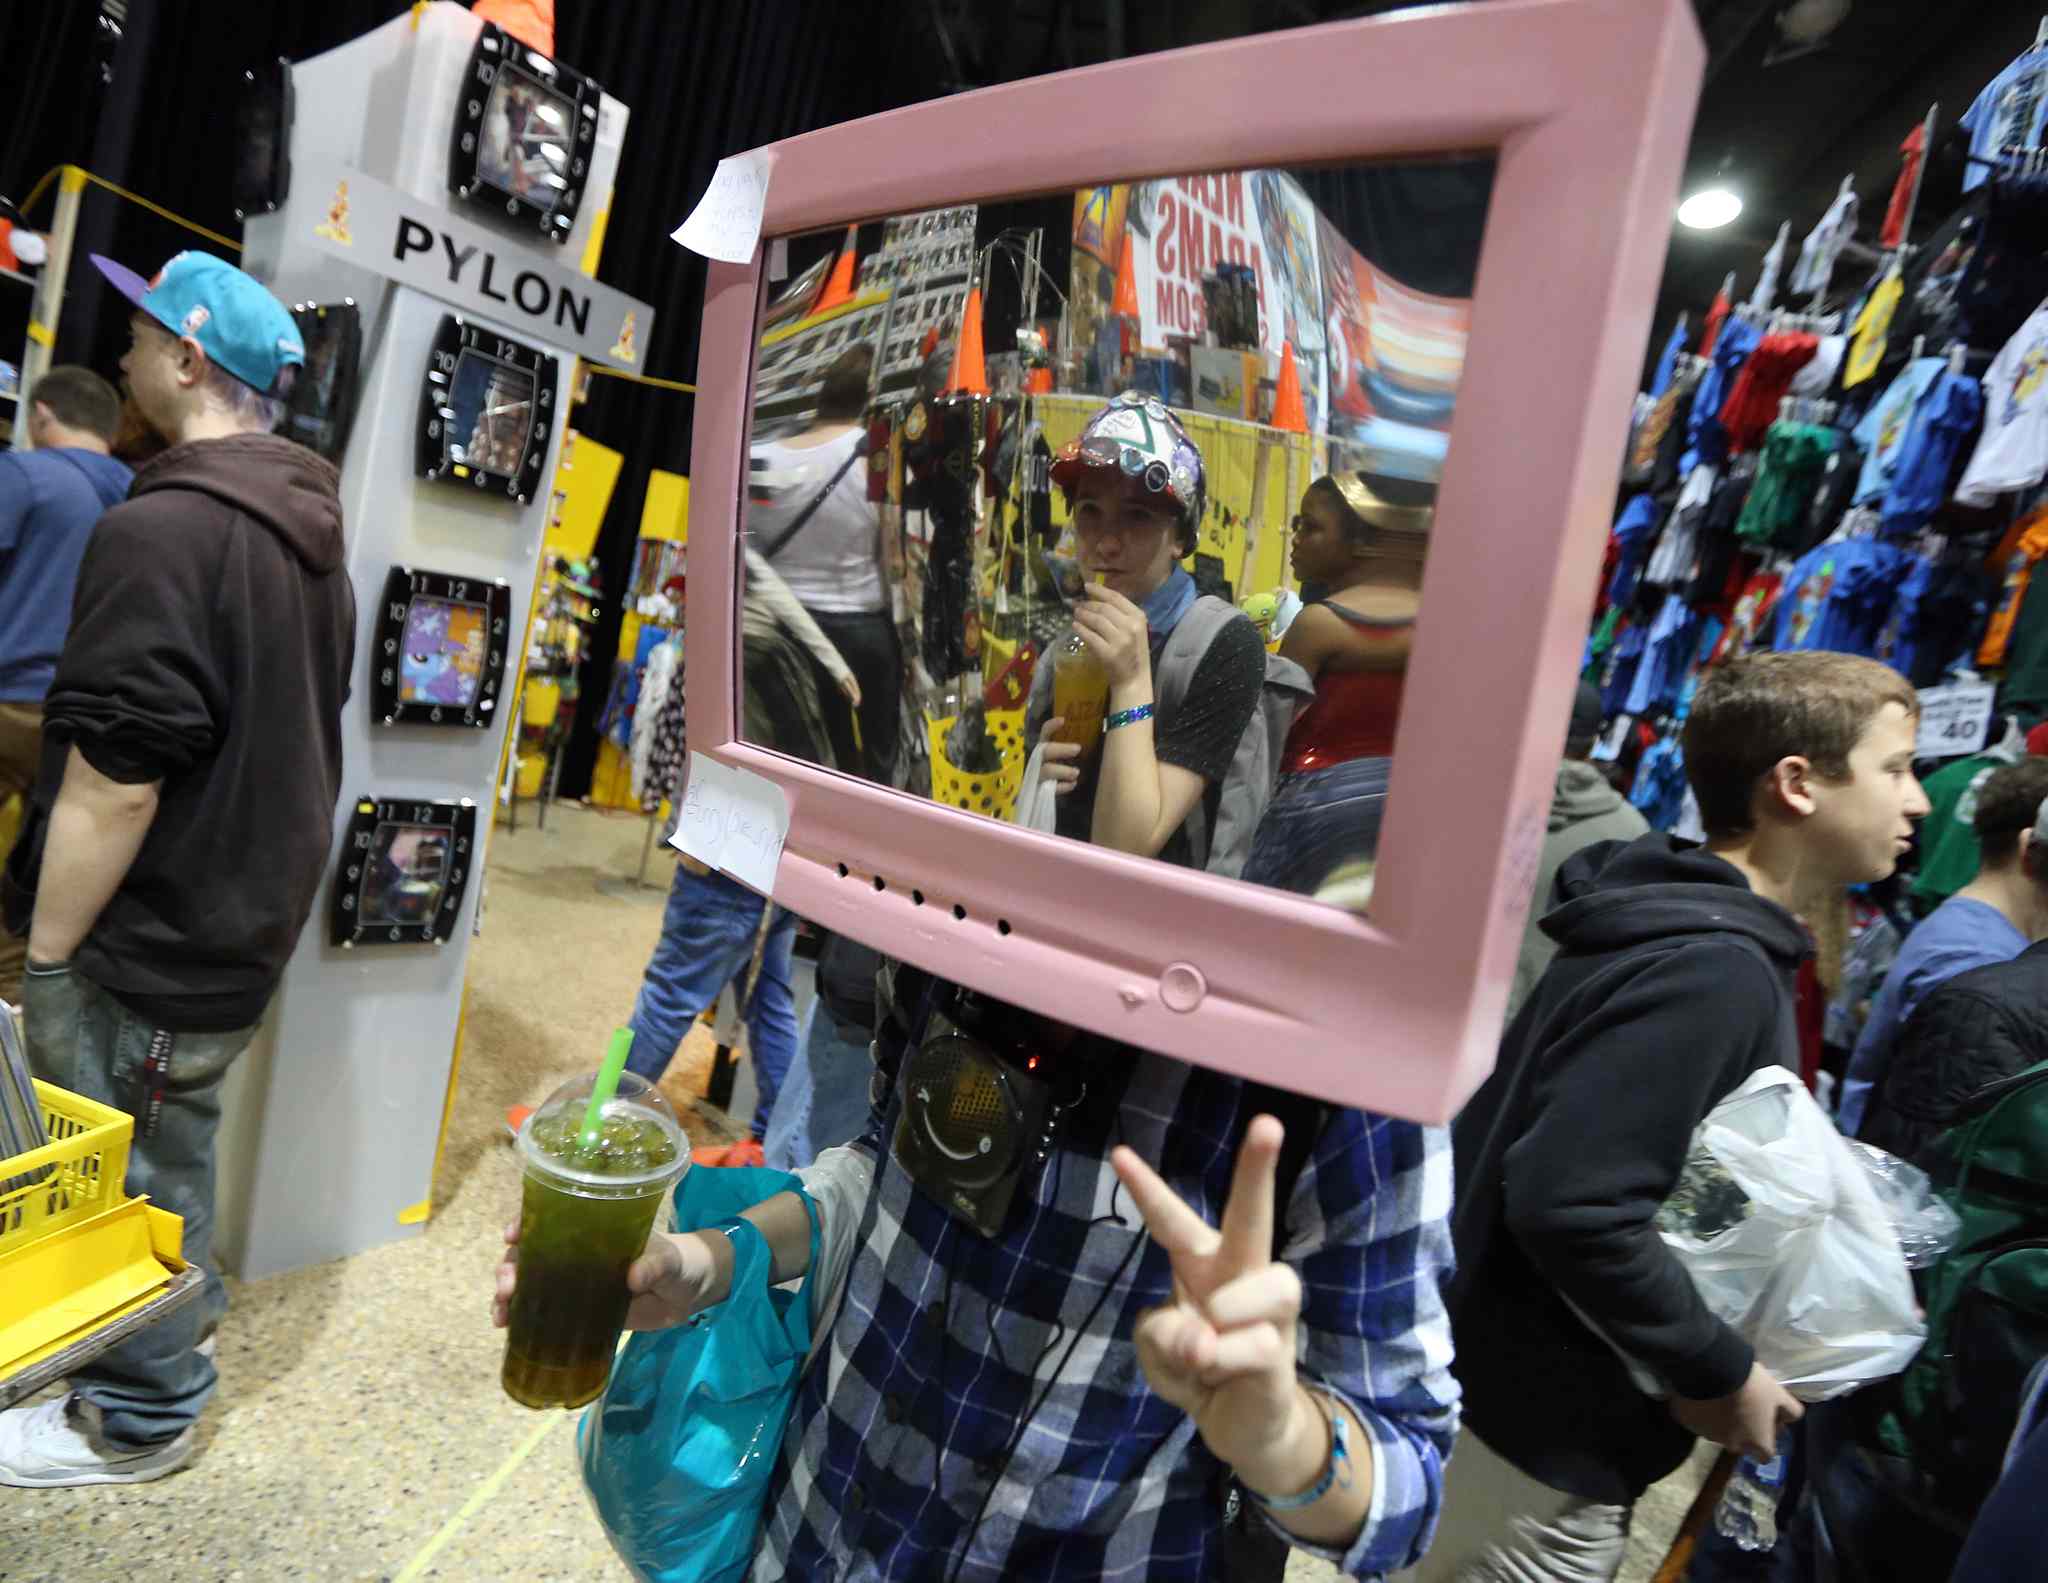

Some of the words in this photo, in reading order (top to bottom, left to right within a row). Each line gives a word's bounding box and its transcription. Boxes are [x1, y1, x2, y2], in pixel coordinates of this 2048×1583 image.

[500, 35, 520, 61] 11
[477, 60, 494, 85] 10
[467, 99, 482, 118] 9
[579, 120, 592, 142] 2
[572, 157, 584, 176] 3
[506, 196, 520, 215] 6
[393, 215, 591, 336] PYLON
[460, 326, 479, 346] 11
[496, 340, 518, 360] 12
[434, 350, 456, 371] 10
[540, 389, 552, 407] 2
[428, 420, 440, 437] 8
[534, 422, 546, 440] 3
[529, 453, 540, 468] 4
[474, 472, 486, 488] 6
[410, 575, 428, 592] 11
[448, 580, 466, 600] 12
[390, 602, 406, 622] 10
[494, 618, 504, 634] 2
[384, 638, 396, 655] 9
[490, 650, 500, 666] 3
[381, 668, 393, 686] 8
[484, 680, 494, 694] 4
[430, 704, 442, 722] 6
[377, 803, 394, 820] 11
[414, 806, 433, 824] 12
[354, 831, 370, 848] 10
[456, 836, 468, 853] 2
[347, 864, 360, 880] 9
[451, 868, 463, 884] 3
[342, 894, 354, 910] 8
[445, 896, 456, 910] 4
[389, 926, 402, 941] 6
